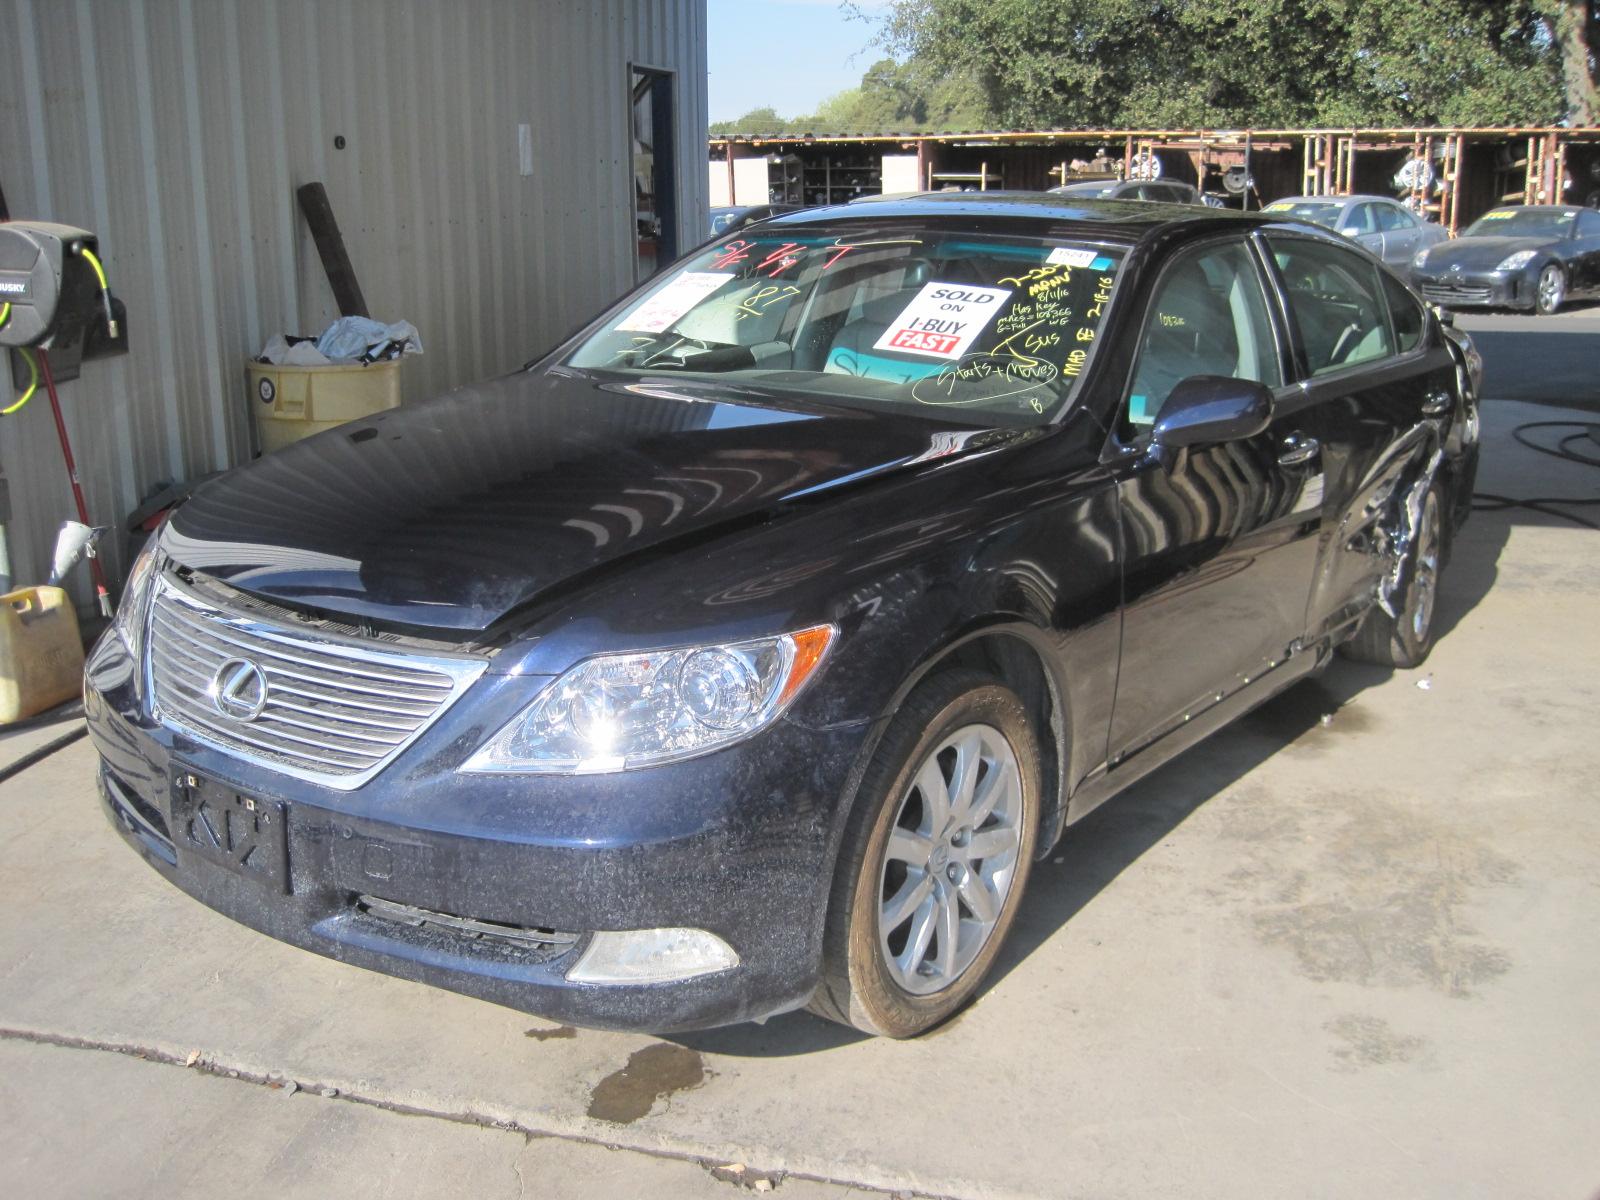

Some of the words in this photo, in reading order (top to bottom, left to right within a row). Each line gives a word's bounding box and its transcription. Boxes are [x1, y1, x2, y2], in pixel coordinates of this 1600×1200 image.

[0, 283, 25, 293] USKY
[931, 288, 995, 305] SOLD
[940, 303, 965, 313] ON
[898, 332, 957, 351] FAST
[1006, 362, 1056, 384] Moves
